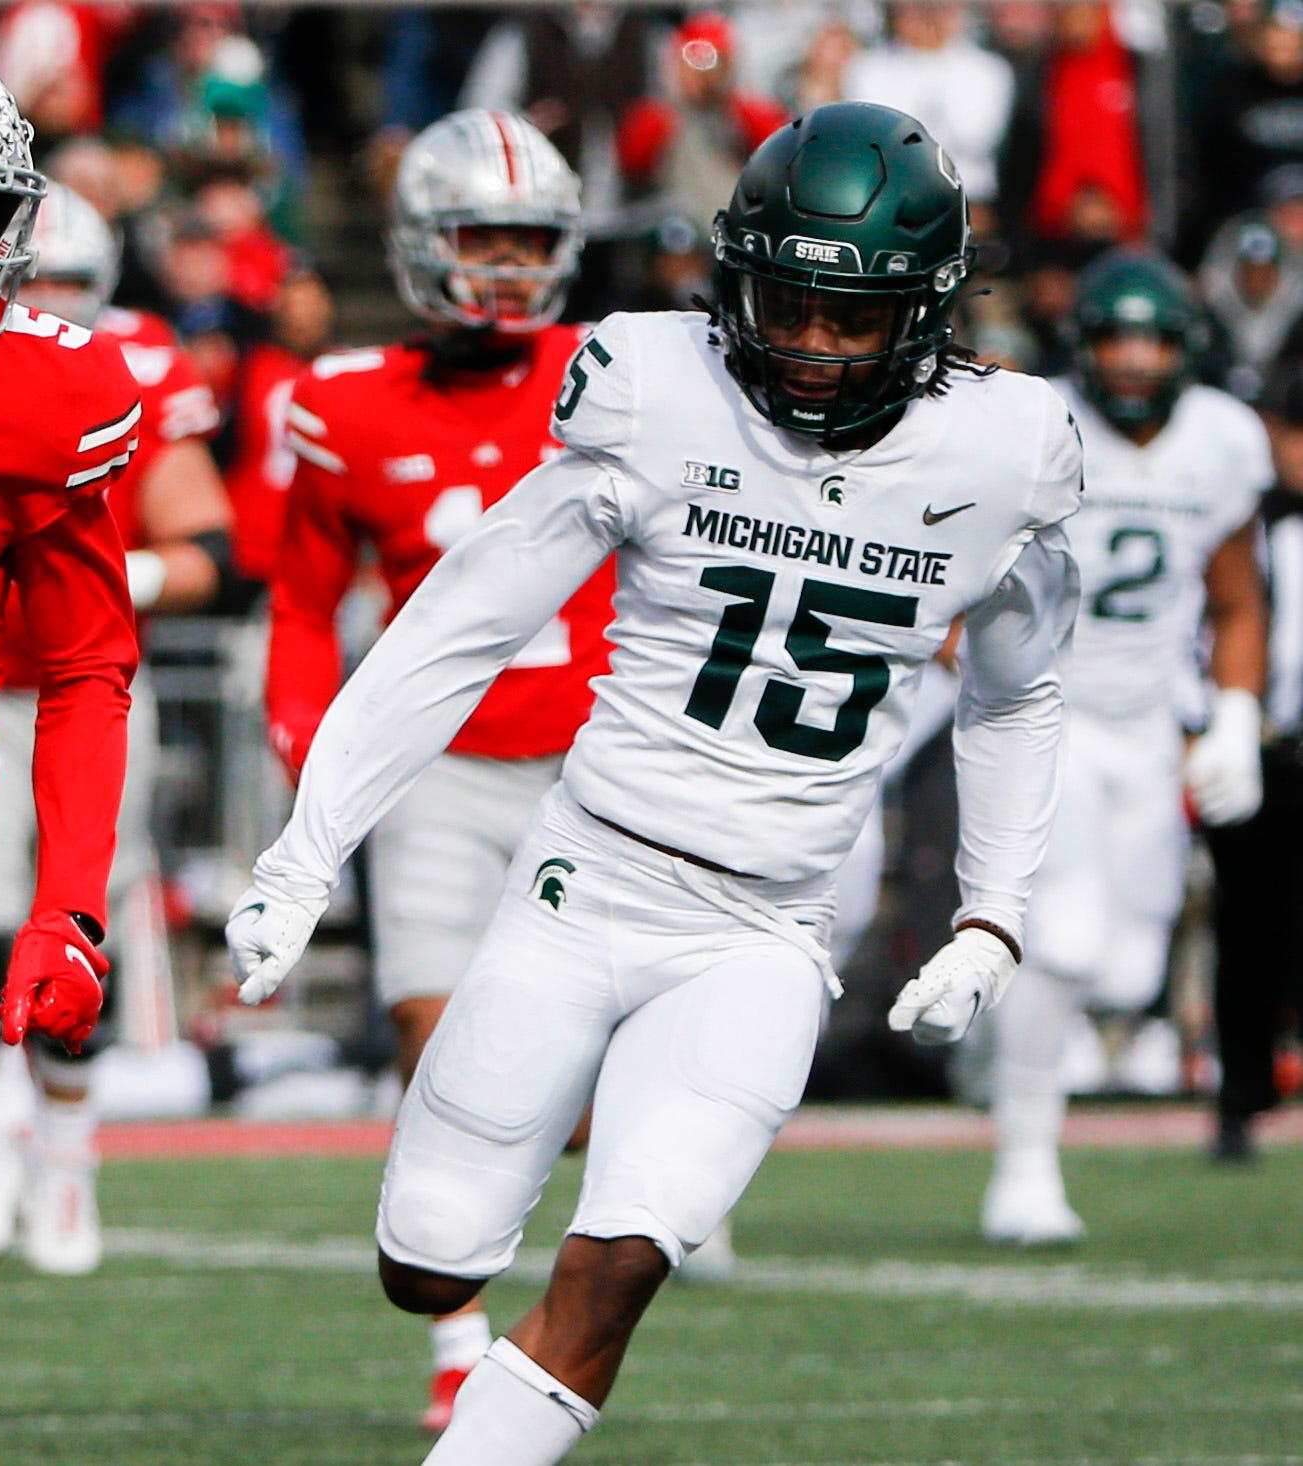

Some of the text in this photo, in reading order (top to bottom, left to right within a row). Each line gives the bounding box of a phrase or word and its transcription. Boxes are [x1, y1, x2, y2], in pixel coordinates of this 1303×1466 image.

[795, 241, 842, 264] STATE
[4, 302, 93, 350] 5
[682, 503, 954, 586] MICHIGAN STATE
[1091, 526, 1166, 623] 2
[683, 564, 921, 763] 15
